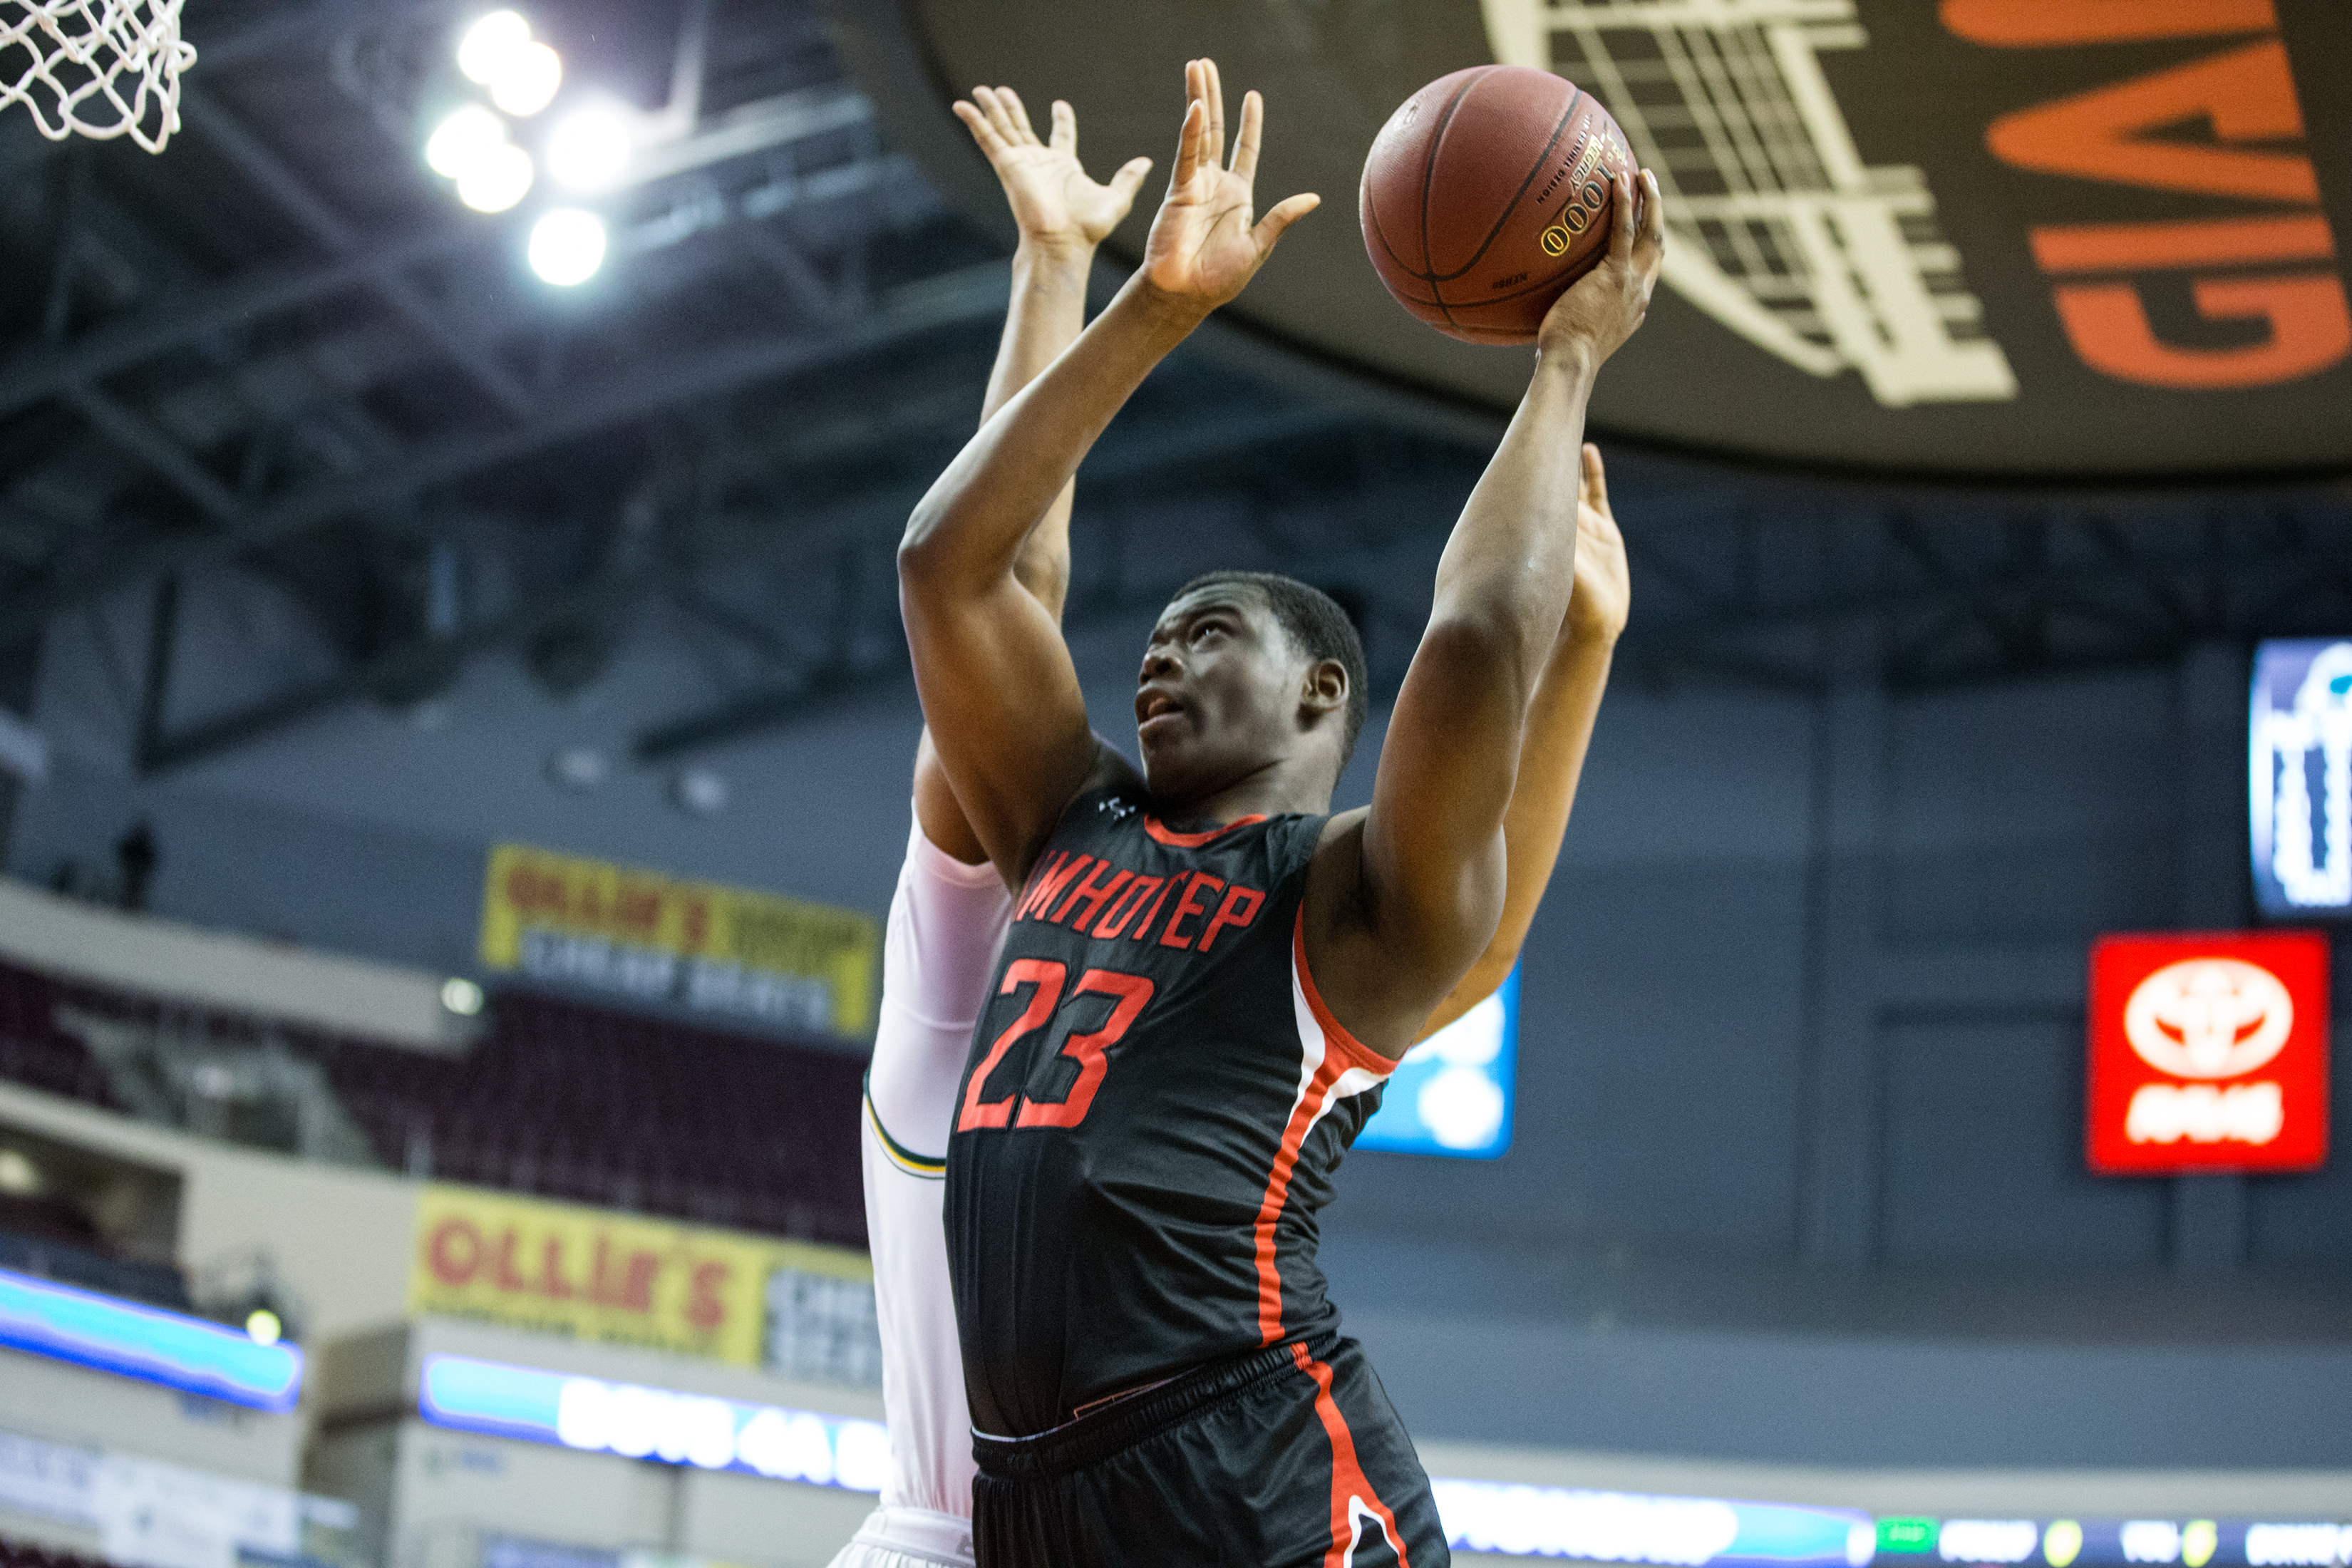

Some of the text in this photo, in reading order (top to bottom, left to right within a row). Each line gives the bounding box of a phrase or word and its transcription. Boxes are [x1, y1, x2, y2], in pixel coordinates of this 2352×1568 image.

[1569, 134, 1604, 197] LEGACY
[1936, 0, 2352, 389] GIA
[956, 958, 1155, 1133] 23
